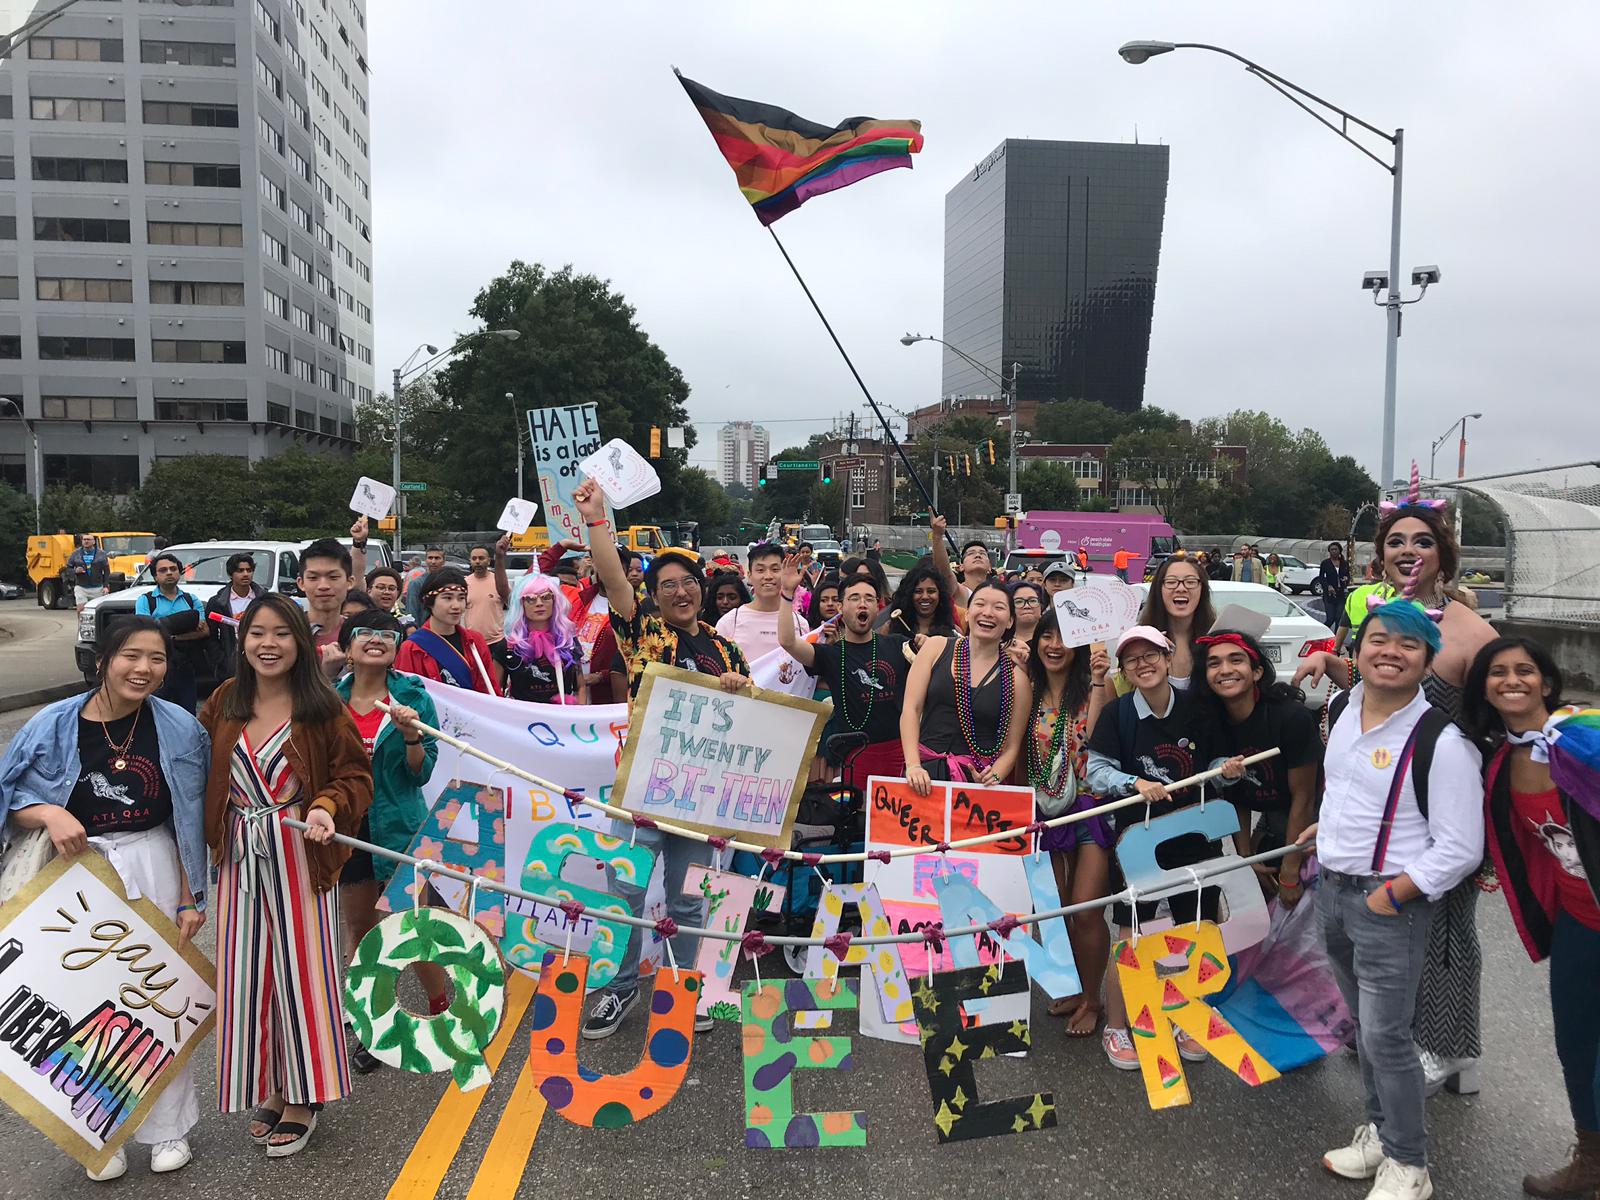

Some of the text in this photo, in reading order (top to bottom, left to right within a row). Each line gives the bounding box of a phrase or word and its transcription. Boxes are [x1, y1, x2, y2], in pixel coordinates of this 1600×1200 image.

[530, 405, 598, 442] HATE
[536, 446, 550, 462] is
[557, 446, 569, 459] a
[560, 460, 579, 477] of
[663, 689, 734, 732] IT'S
[528, 721, 628, 747] QUE
[660, 726, 772, 773] TWENTY
[644, 758, 792, 824] BI-TEEN
[92, 808, 150, 822] ATL Q&A
[875, 786, 943, 846] QUEER
[60, 919, 190, 1018] gay
[0, 938, 176, 1143] IBERASIAN
[345, 906, 1281, 1148] QUEER
